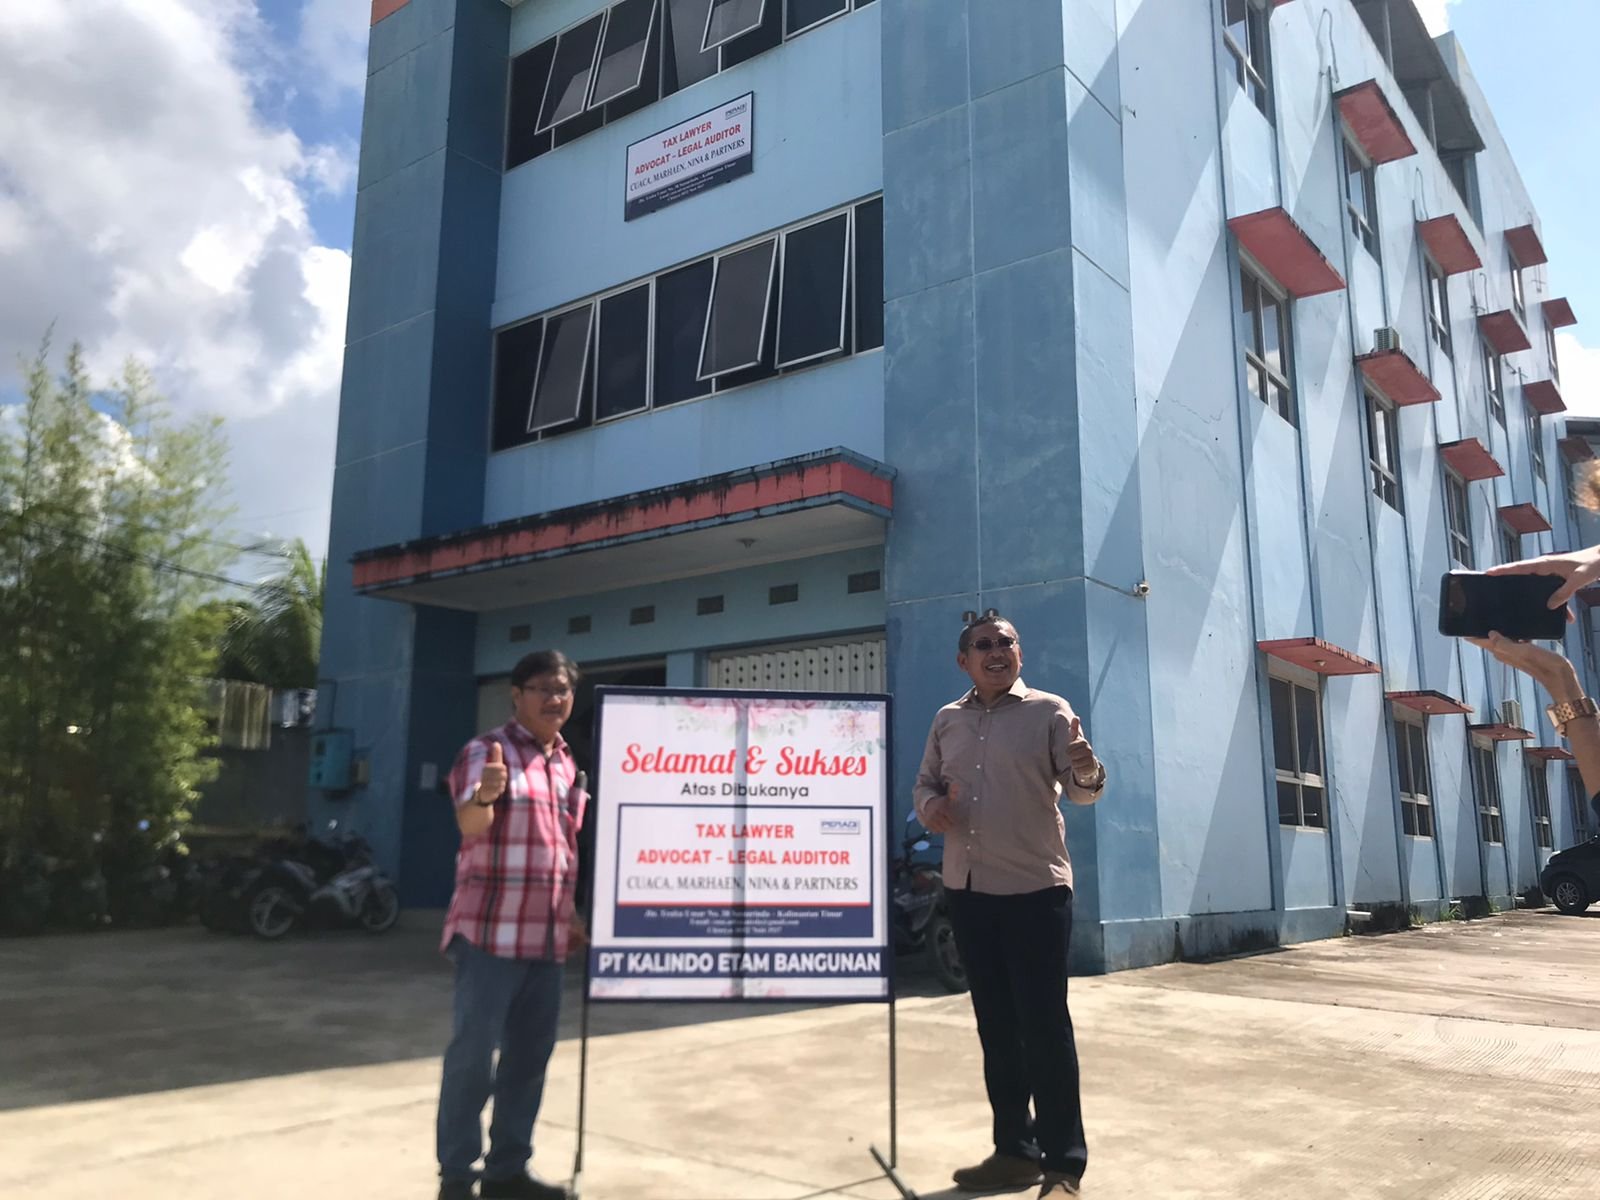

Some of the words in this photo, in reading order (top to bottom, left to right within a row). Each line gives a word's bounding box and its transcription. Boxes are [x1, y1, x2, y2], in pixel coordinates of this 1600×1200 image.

[662, 139, 678, 149] TAX
[680, 121, 712, 142] LAWYER
[635, 154, 670, 175] ADVOCAT
[677, 141, 703, 158] LEGAL
[704, 124, 741, 146] AUDITOR
[687, 156, 704, 169] NINA
[704, 152, 710, 161] &
[710, 138, 745, 159] PARTNERS
[621, 743, 737, 773] Selamat
[744, 746, 767, 774] &
[776, 746, 867, 776] Sukses
[680, 783, 716, 796] Atas
[722, 783, 809, 799] Dibukanya
[696, 824, 726, 838] TAX
[732, 824, 795, 838] LAWYER
[637, 849, 712, 864] ADVOCAT
[728, 850, 777, 864] LEGAL
[782, 851, 850, 865] AUDITOR
[748, 877, 779, 890] NINA
[782, 877, 792, 890] &
[794, 877, 859, 890] PARTNERS
[599, 953, 623, 972] PT
[628, 953, 714, 973] KALINDO
[717, 953, 770, 973] ETAM
[774, 953, 881, 973] BANGUNAN
